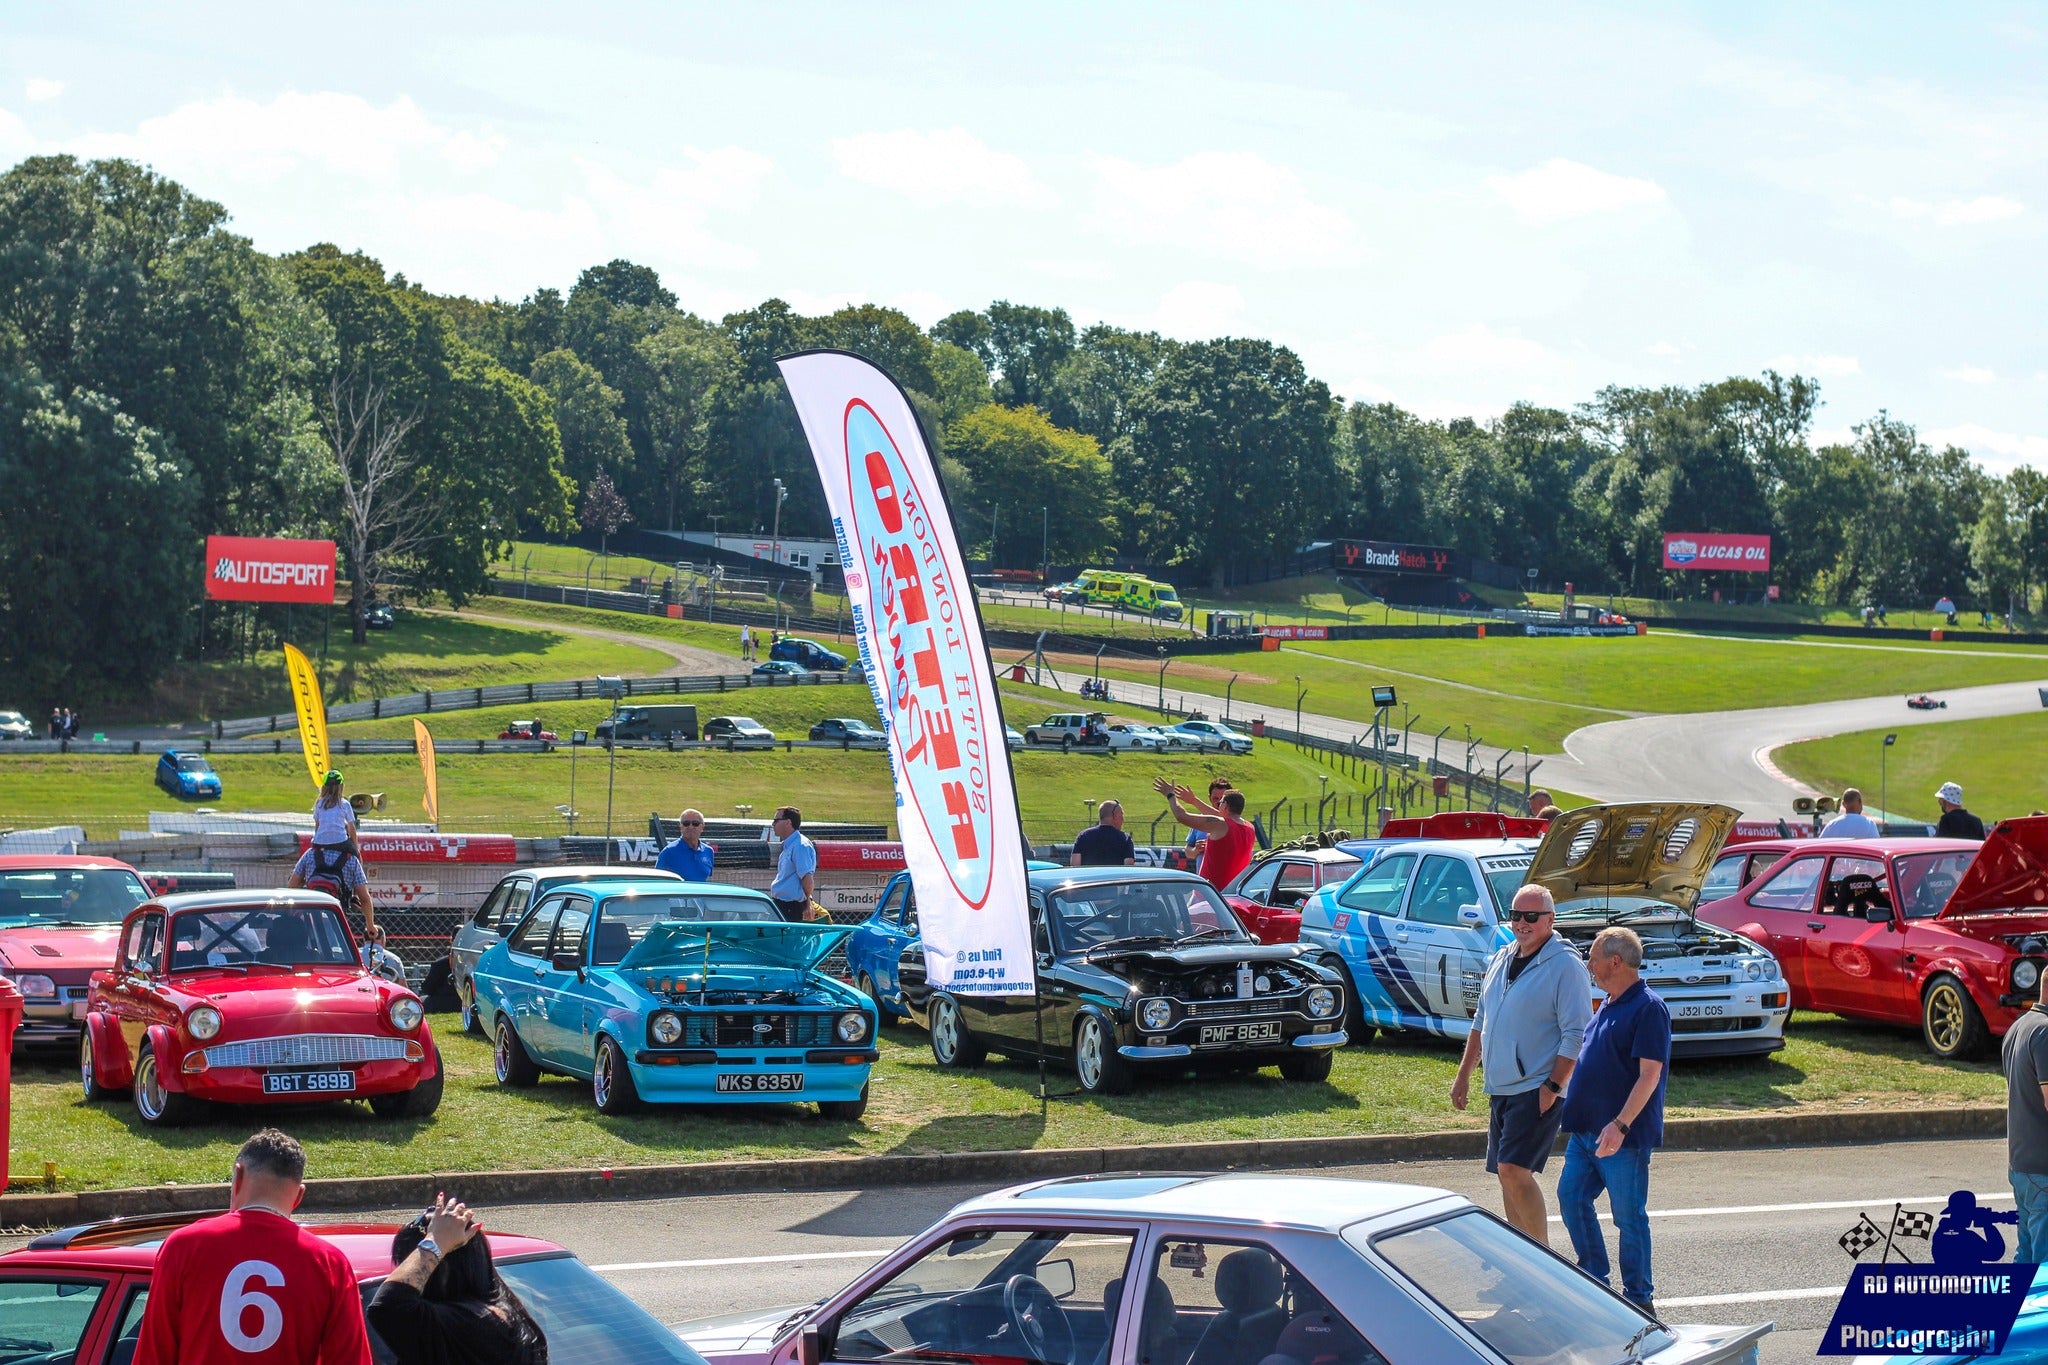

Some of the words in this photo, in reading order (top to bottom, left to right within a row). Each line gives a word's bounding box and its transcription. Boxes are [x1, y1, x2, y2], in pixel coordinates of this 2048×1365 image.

[1365, 548, 1427, 569] BrandsHatch
[1699, 545, 1743, 559] LUCAS
[1745, 547, 1766, 560] OIL
[223, 560, 329, 586] AUTOSPORT
[358, 839, 435, 852] randsHatch
[1486, 858, 1532, 869] FORD
[1438, 953, 1449, 1005] 1
[1704, 1005, 1724, 1016] COS
[1201, 1026, 1236, 1043] PMF
[1237, 1022, 1280, 1040] 863L
[269, 1075, 301, 1091] BGT
[307, 1073, 350, 1089] 589B
[718, 1074, 753, 1091] WKS
[756, 1074, 804, 1090] 635V
[219, 1259, 287, 1353] 6
